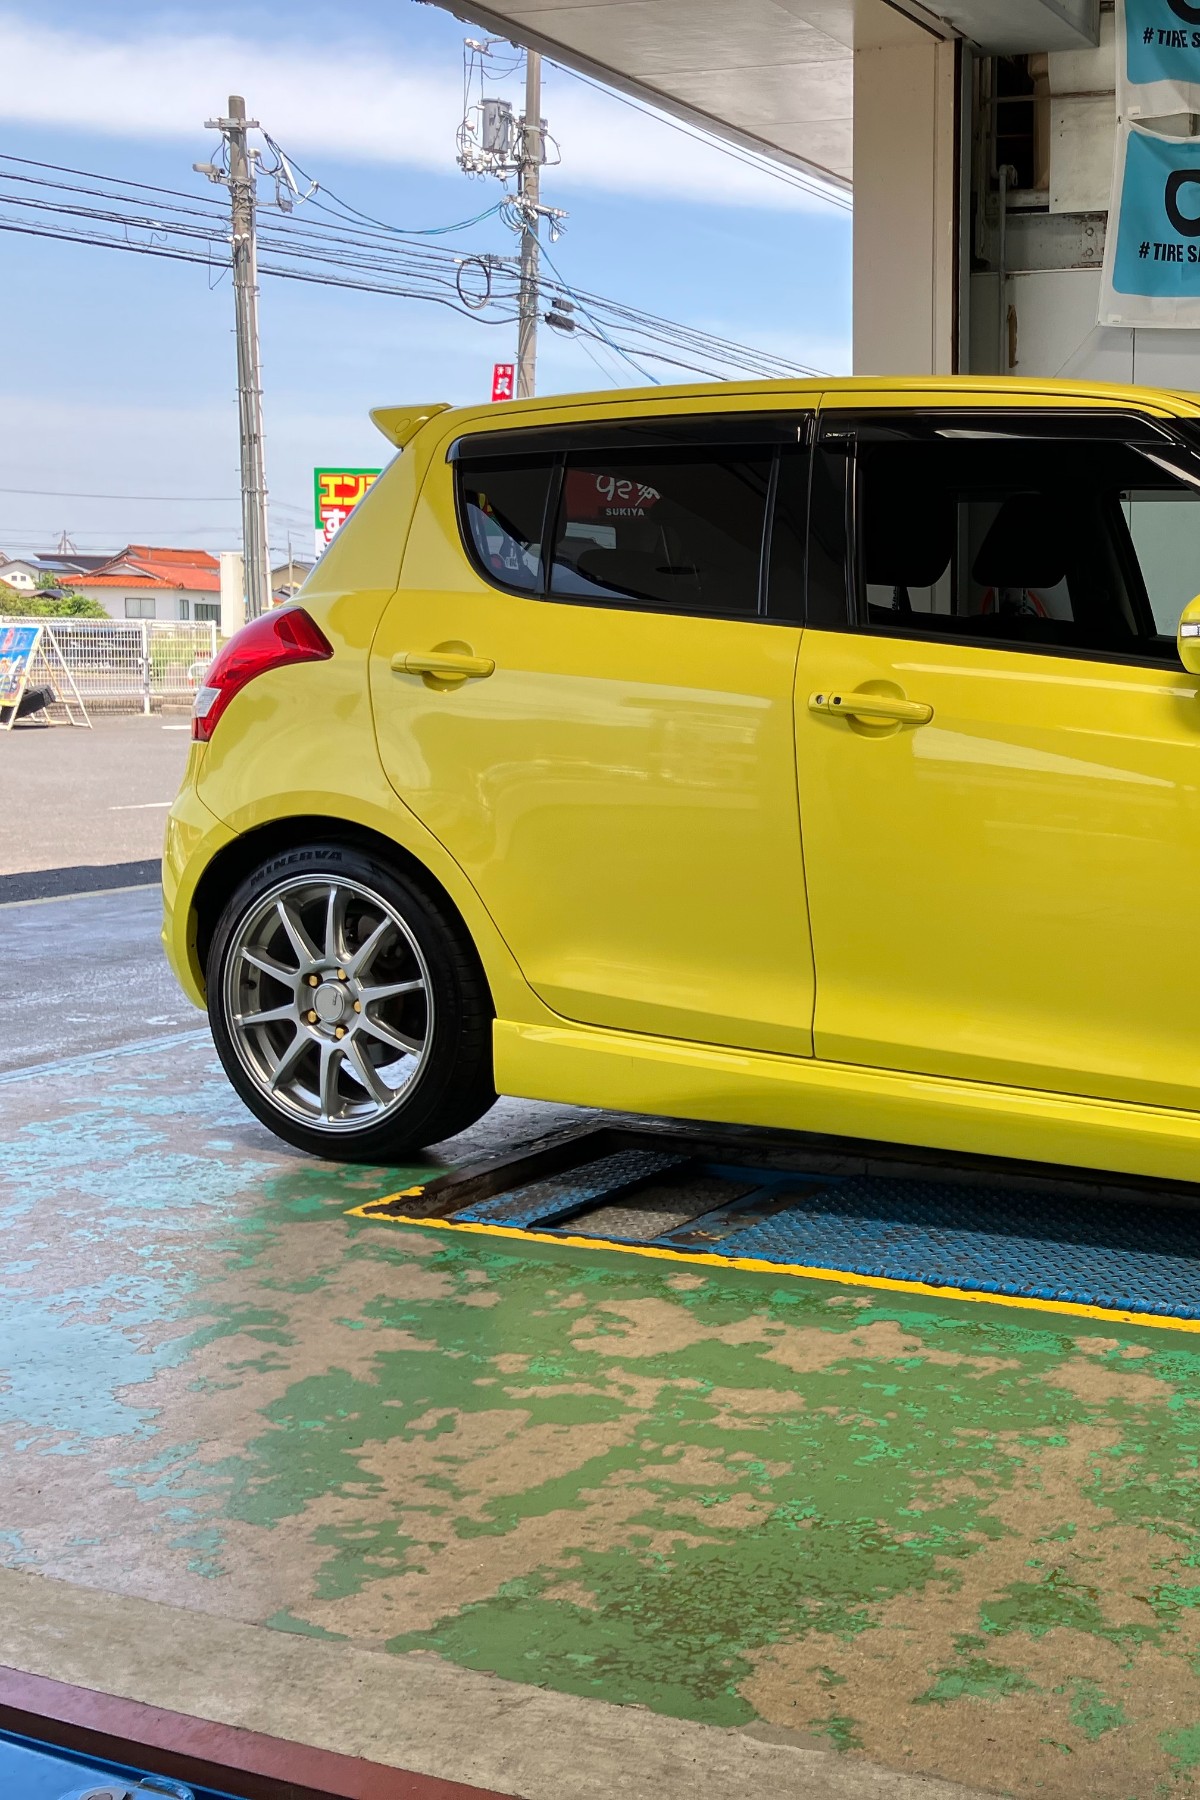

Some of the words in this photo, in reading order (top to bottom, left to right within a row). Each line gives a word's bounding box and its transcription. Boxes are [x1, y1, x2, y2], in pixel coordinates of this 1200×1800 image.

[1157, 29, 1189, 48] TIRE
[1153, 242, 1184, 263] TIRE
[605, 507, 645, 516] SUKIYA
